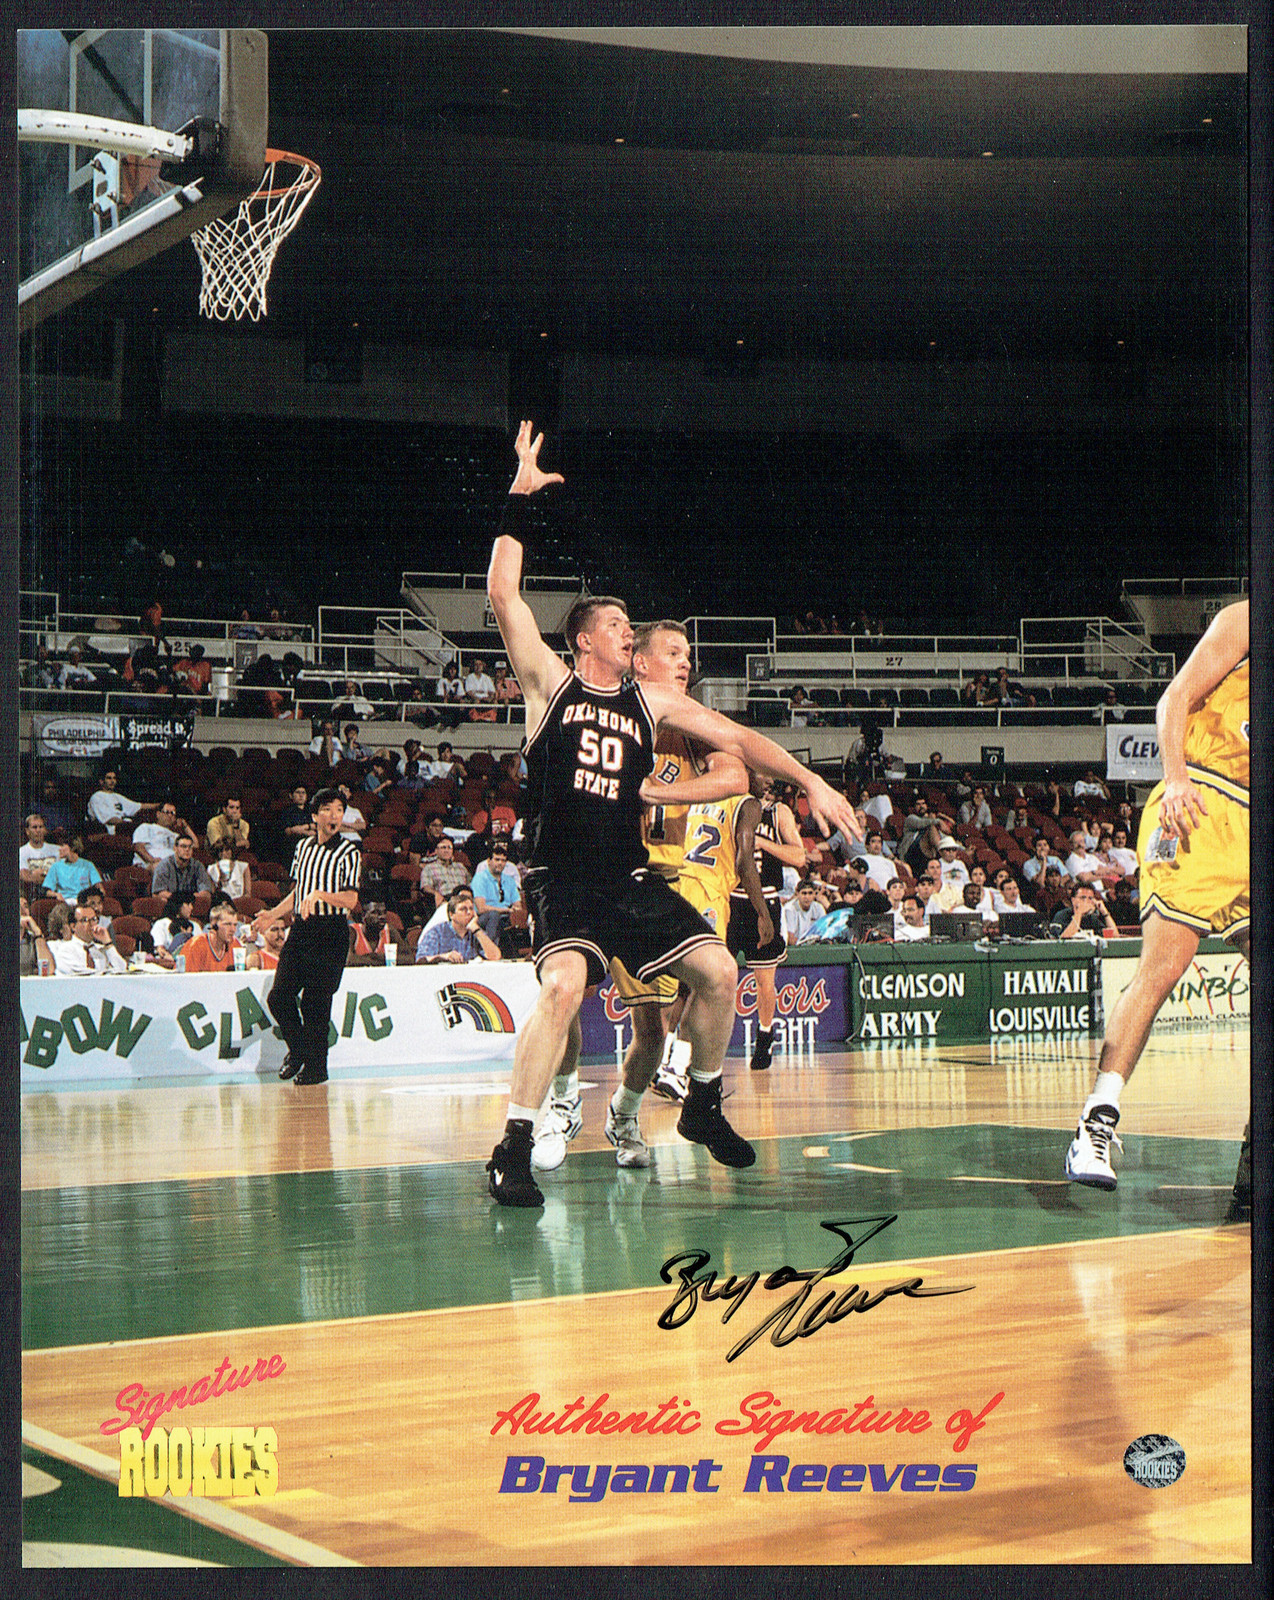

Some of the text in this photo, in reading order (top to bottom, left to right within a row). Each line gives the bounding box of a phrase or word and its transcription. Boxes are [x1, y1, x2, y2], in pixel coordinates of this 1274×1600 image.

[886, 656, 904, 667] 27
[562, 701, 642, 746] OKLHOM
[577, 728, 624, 772] 50
[574, 768, 620, 800] STATE
[735, 971, 831, 1017] Cors
[859, 972, 965, 1000] CLEMSON
[1004, 969, 1089, 996] HAWAII
[177, 986, 394, 1060] CLAIC
[743, 1016, 819, 1046] LGHT
[860, 1010, 942, 1038] ARMY
[989, 1005, 1090, 1033] LOUISVILLE
